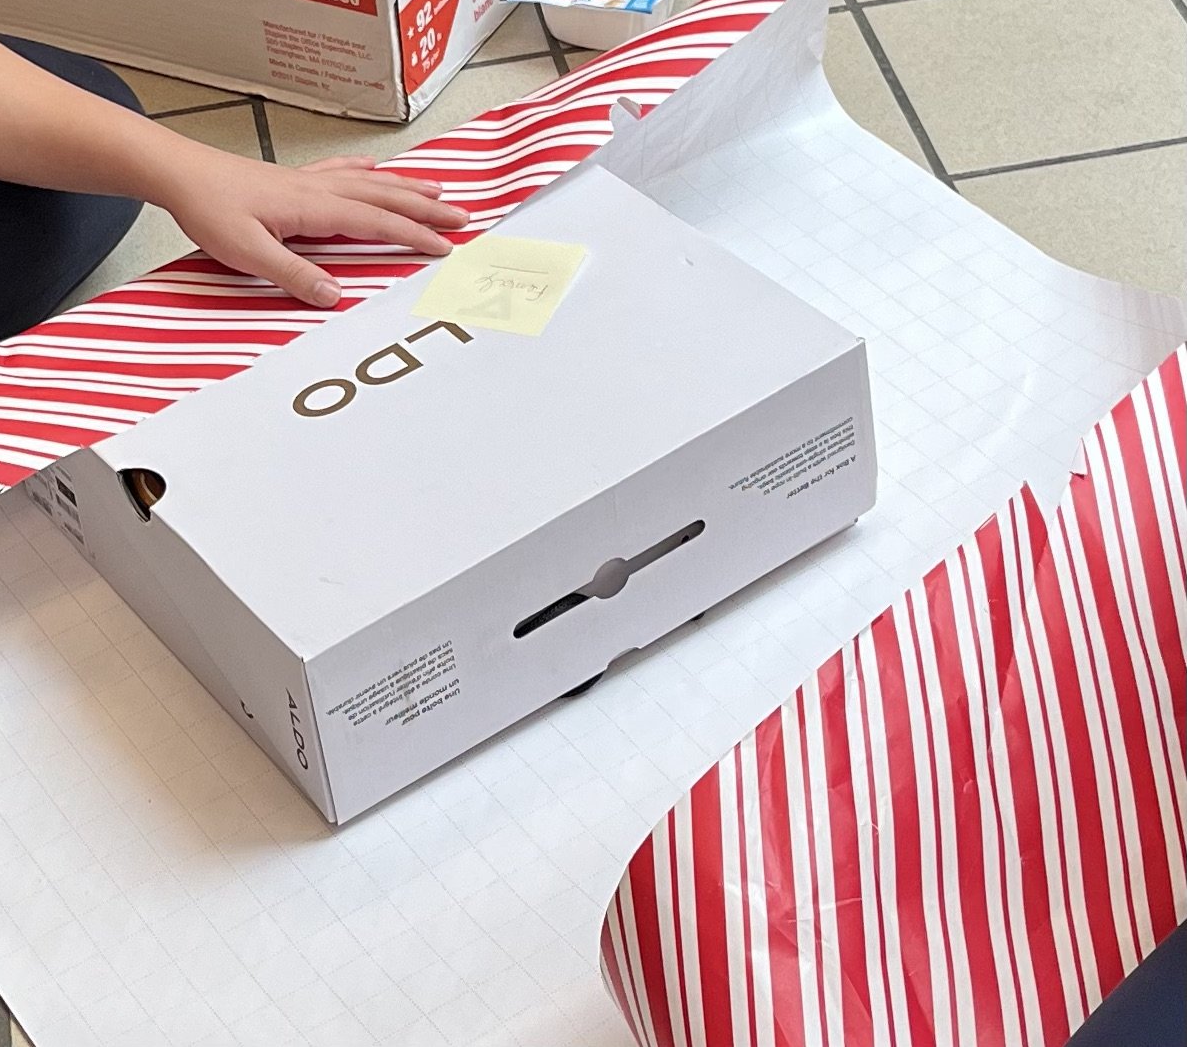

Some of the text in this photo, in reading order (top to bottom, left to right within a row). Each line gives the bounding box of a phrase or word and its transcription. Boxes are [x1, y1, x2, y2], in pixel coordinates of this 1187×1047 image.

[416, 1, 433, 33] 92
[420, 28, 436, 60] 20
[292, 291, 510, 417] LDO
[787, 454, 856, 499] A Box for the Better
[428, 645, 441, 655] pas
[442, 640, 452, 648] Un
[419, 653, 428, 662] de
[428, 657, 436, 665] de
[404, 659, 418, 671] plus
[443, 663, 456, 673] Une
[388, 669, 402, 680] vers
[422, 672, 441, 686] corde
[377, 678, 386, 686] un
[356, 684, 376, 700] avenir
[445, 688, 460, 699] Une
[385, 678, 459, 725] un monde meilleur
[348, 712, 357, 721] de
[353, 713, 372, 726] cette
[402, 710, 420, 725] pour
[286, 687, 308, 770] ALDO
